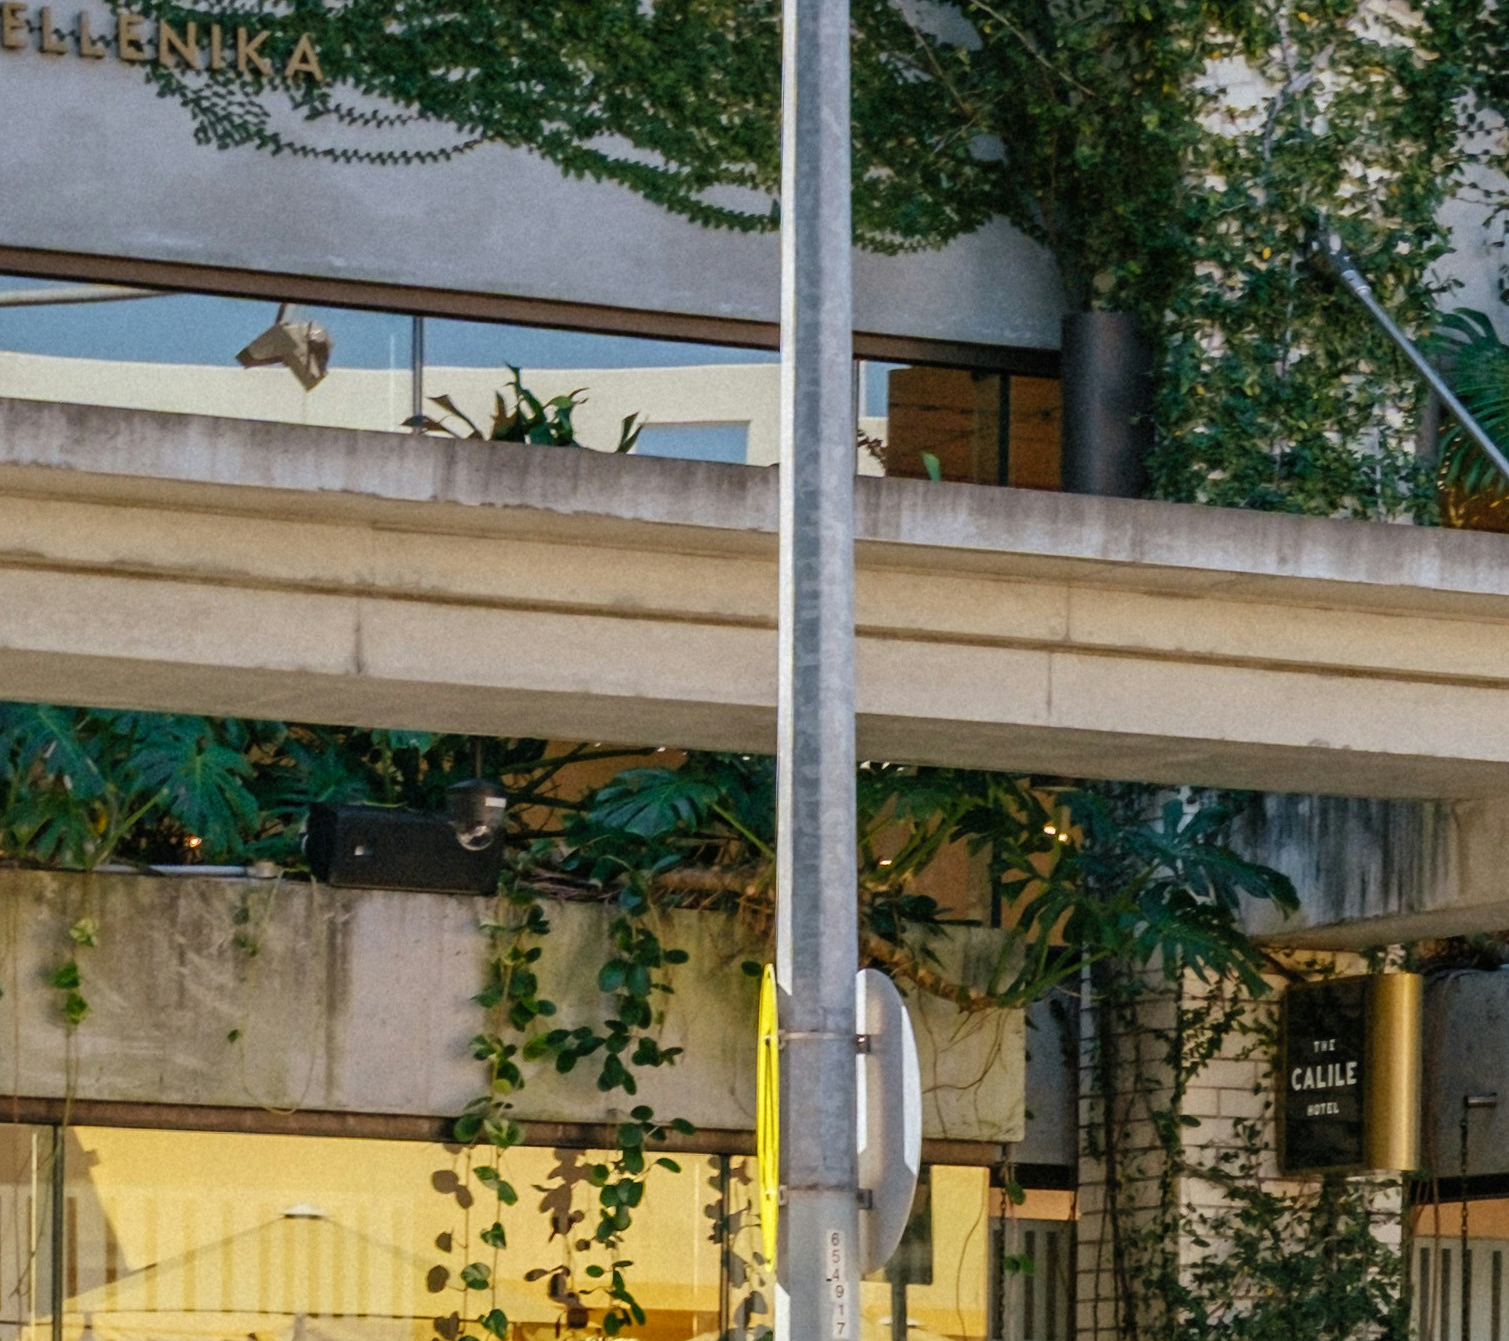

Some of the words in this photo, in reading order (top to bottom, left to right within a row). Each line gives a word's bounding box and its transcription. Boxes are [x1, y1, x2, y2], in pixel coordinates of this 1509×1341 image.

[1313, 1038, 1336, 1053] THE
[1290, 1061, 1358, 1091] CALILE
[1306, 1101, 1340, 1117] HOTEL
[830, 1231, 846, 1335] 654917
